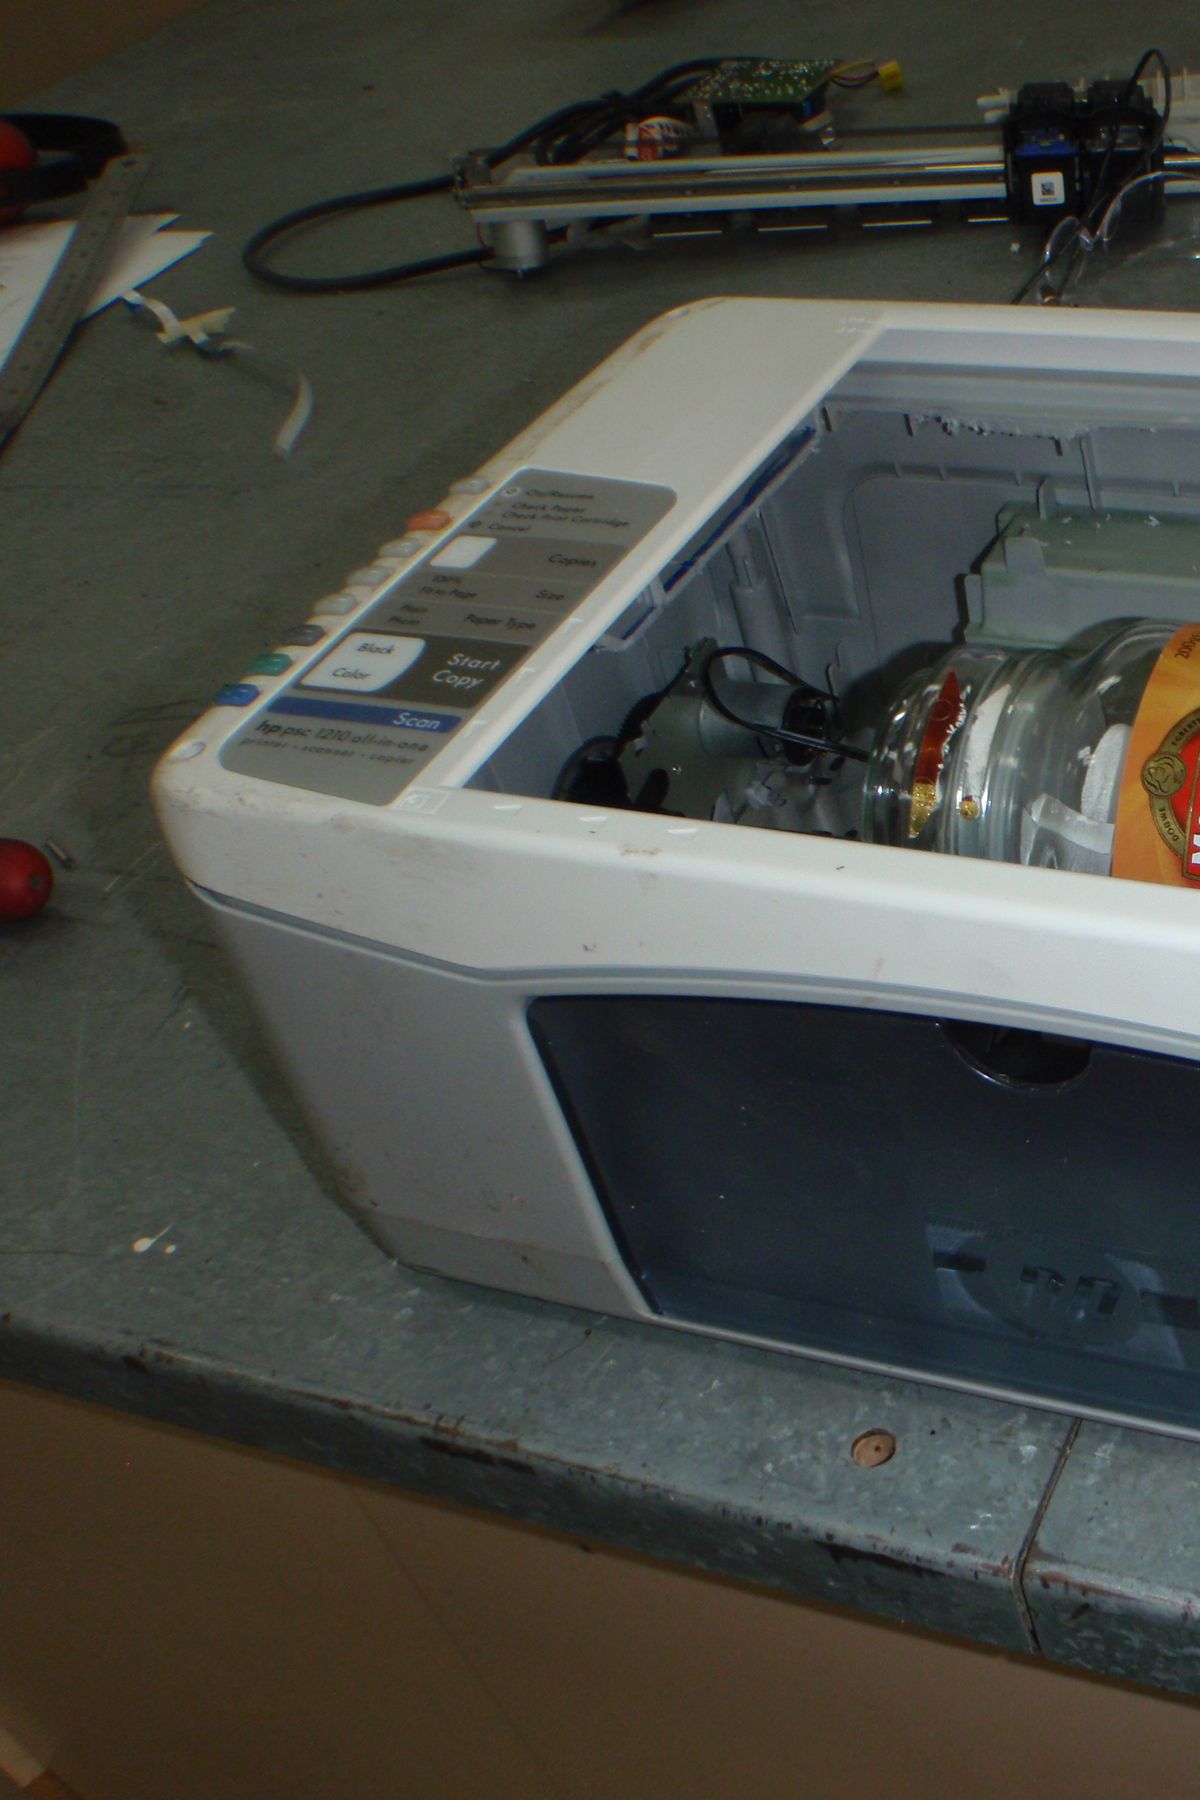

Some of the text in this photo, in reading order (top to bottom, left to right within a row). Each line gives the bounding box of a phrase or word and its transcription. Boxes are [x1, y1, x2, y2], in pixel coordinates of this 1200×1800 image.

[548, 553, 598, 568] Copies
[535, 589, 565, 601] Size
[463, 612, 537, 631] Paper Type
[356, 642, 395, 655] Black
[447, 652, 502, 671] Start
[332, 666, 372, 680] Color
[432, 669, 485, 690] Copy
[392, 711, 441, 730] Scan
[254, 718, 430, 753] hp psc 1210 all-in-one
[301, 742, 356, 758] scanner
